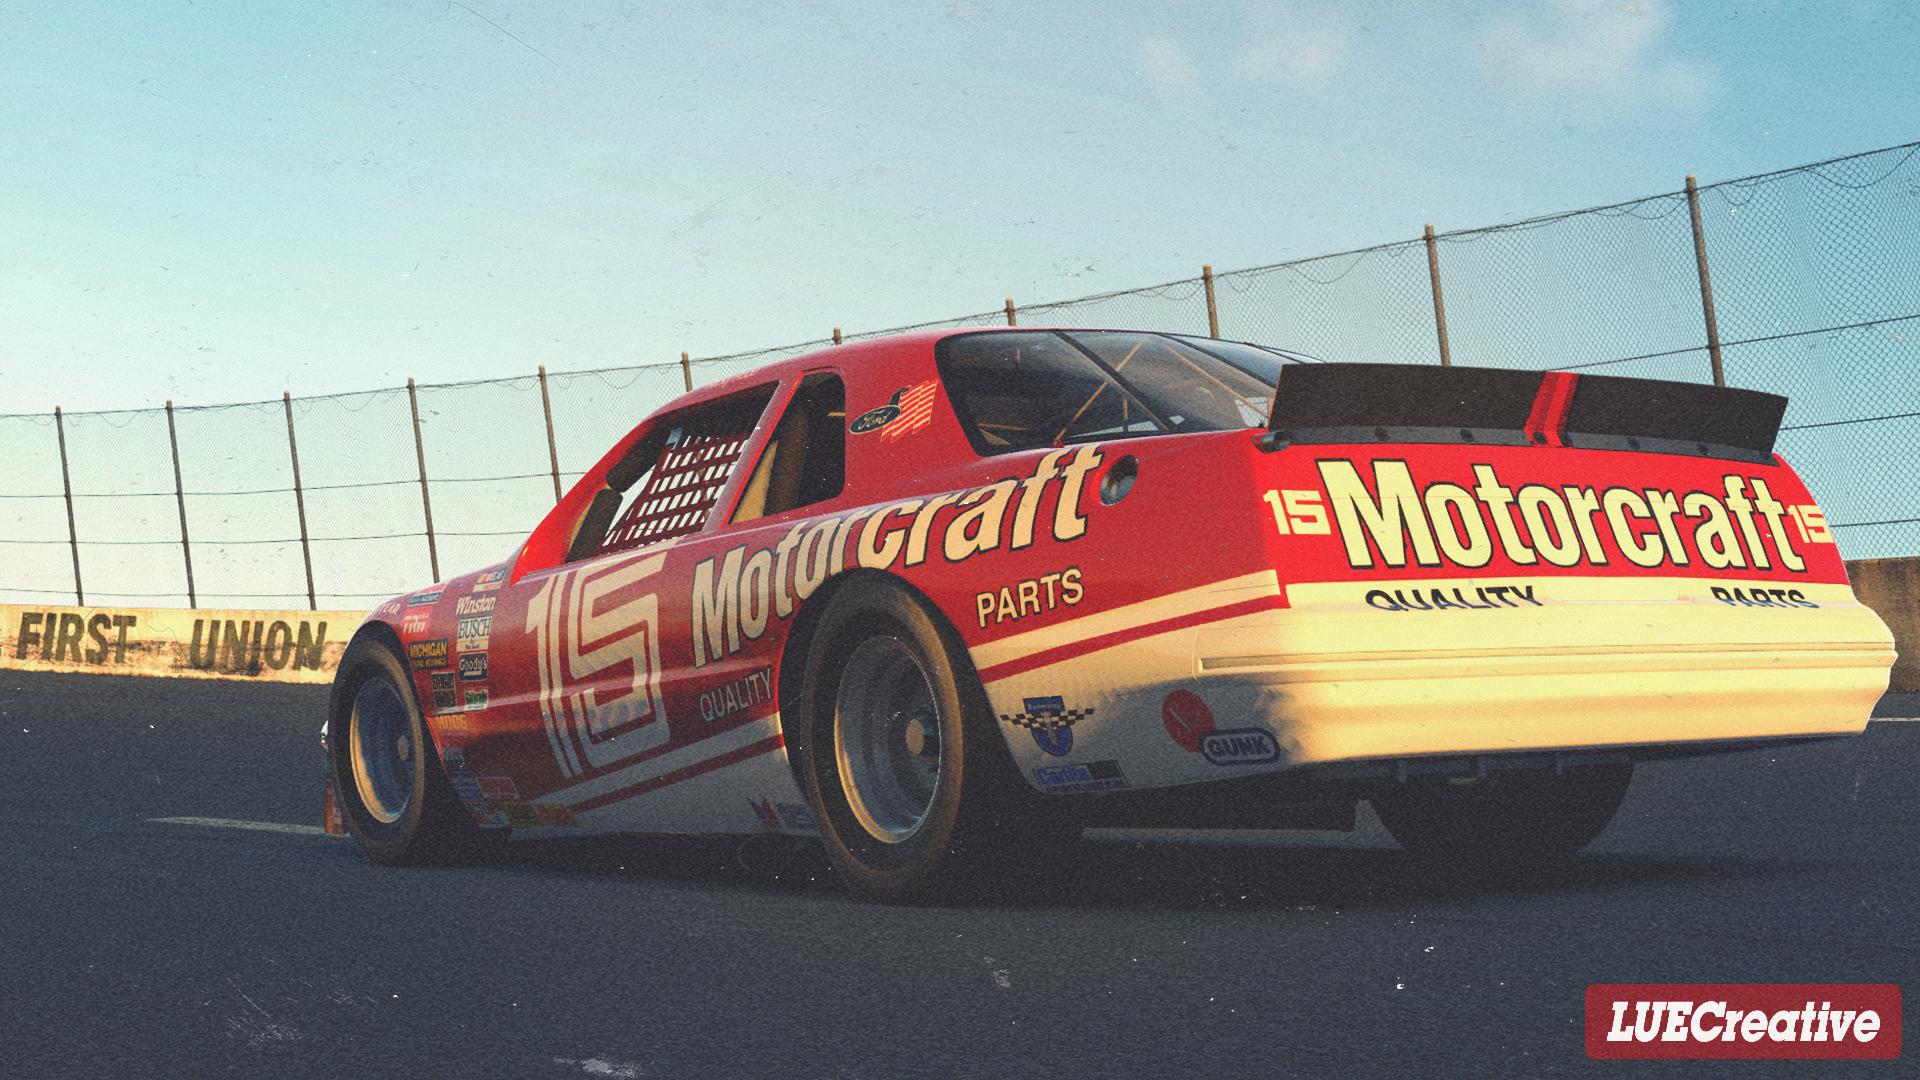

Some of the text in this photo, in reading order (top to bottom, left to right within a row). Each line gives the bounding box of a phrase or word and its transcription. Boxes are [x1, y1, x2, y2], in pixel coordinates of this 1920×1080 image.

[857, 409, 893, 431] Ford
[1262, 489, 1332, 536] 15
[1314, 458, 1808, 573] Motorcraft
[1788, 504, 1835, 544] 15
[691, 444, 1103, 668] Motorcraft
[455, 594, 497, 616] Winston
[975, 567, 1085, 630] PARTS
[1365, 585, 1544, 612] QUALITY
[1710, 586, 1820, 609] PARTS
[15, 611, 328, 677] FIRST UNION
[458, 617, 493, 639] BUSCH
[409, 641, 448, 657] MICHIGAN
[459, 656, 488, 672] Goody's
[525, 538, 685, 780] 15
[699, 667, 772, 723] QUALITY
[1207, 735, 1272, 759] GUNK
